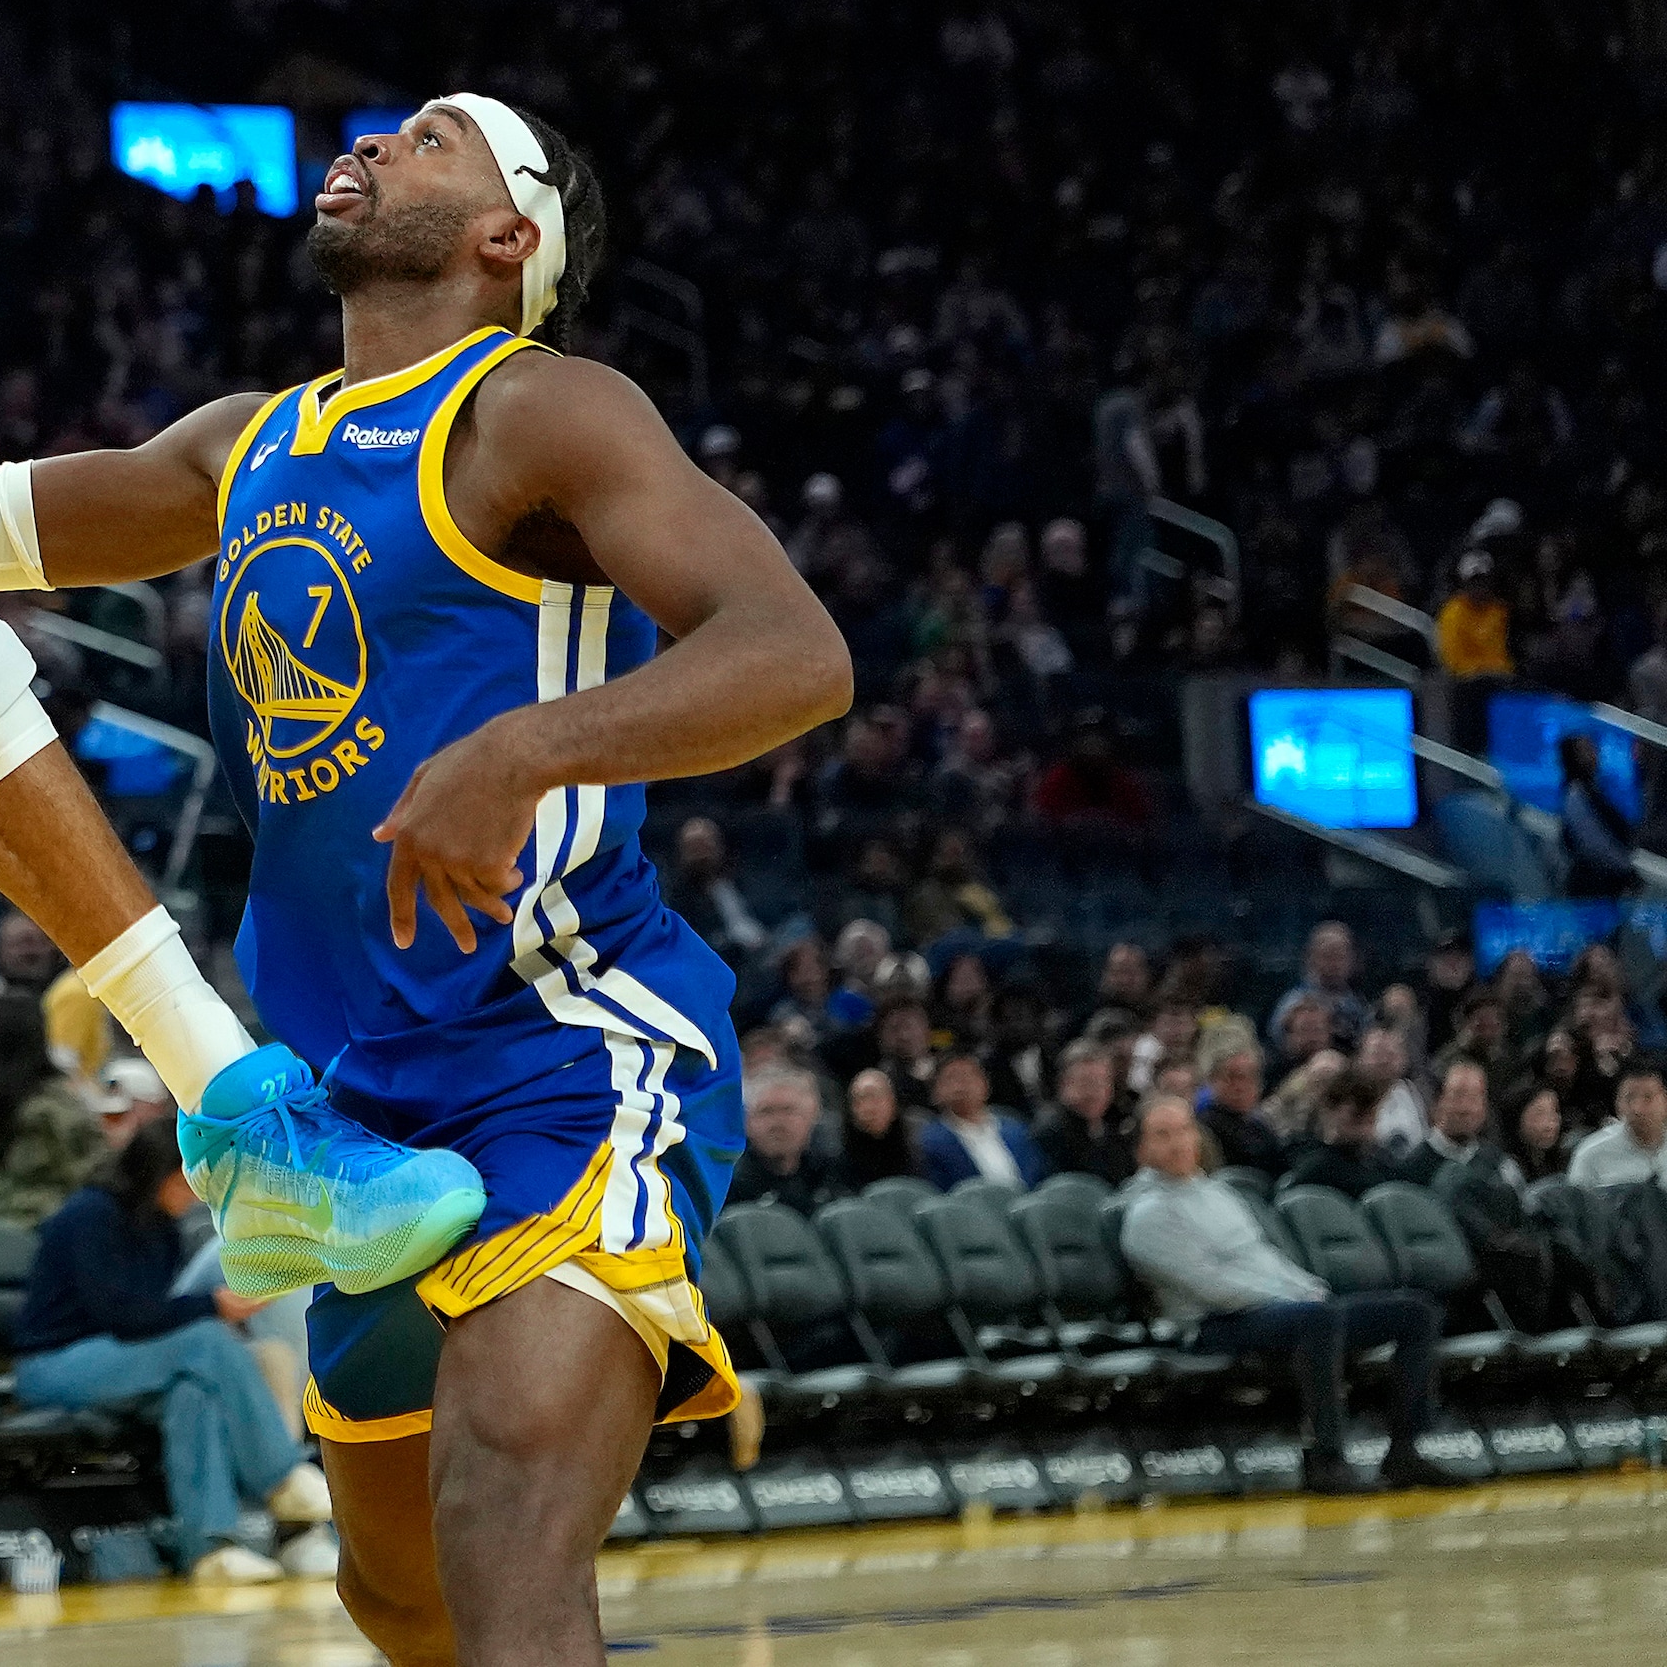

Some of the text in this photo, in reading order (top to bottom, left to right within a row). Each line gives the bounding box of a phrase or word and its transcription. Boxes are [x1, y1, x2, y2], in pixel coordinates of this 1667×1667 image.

[342, 422, 420, 448] Rakuten
[219, 501, 372, 582] GOLDEN STATE
[303, 585, 332, 648] 7
[261, 1072, 287, 1103] 27
